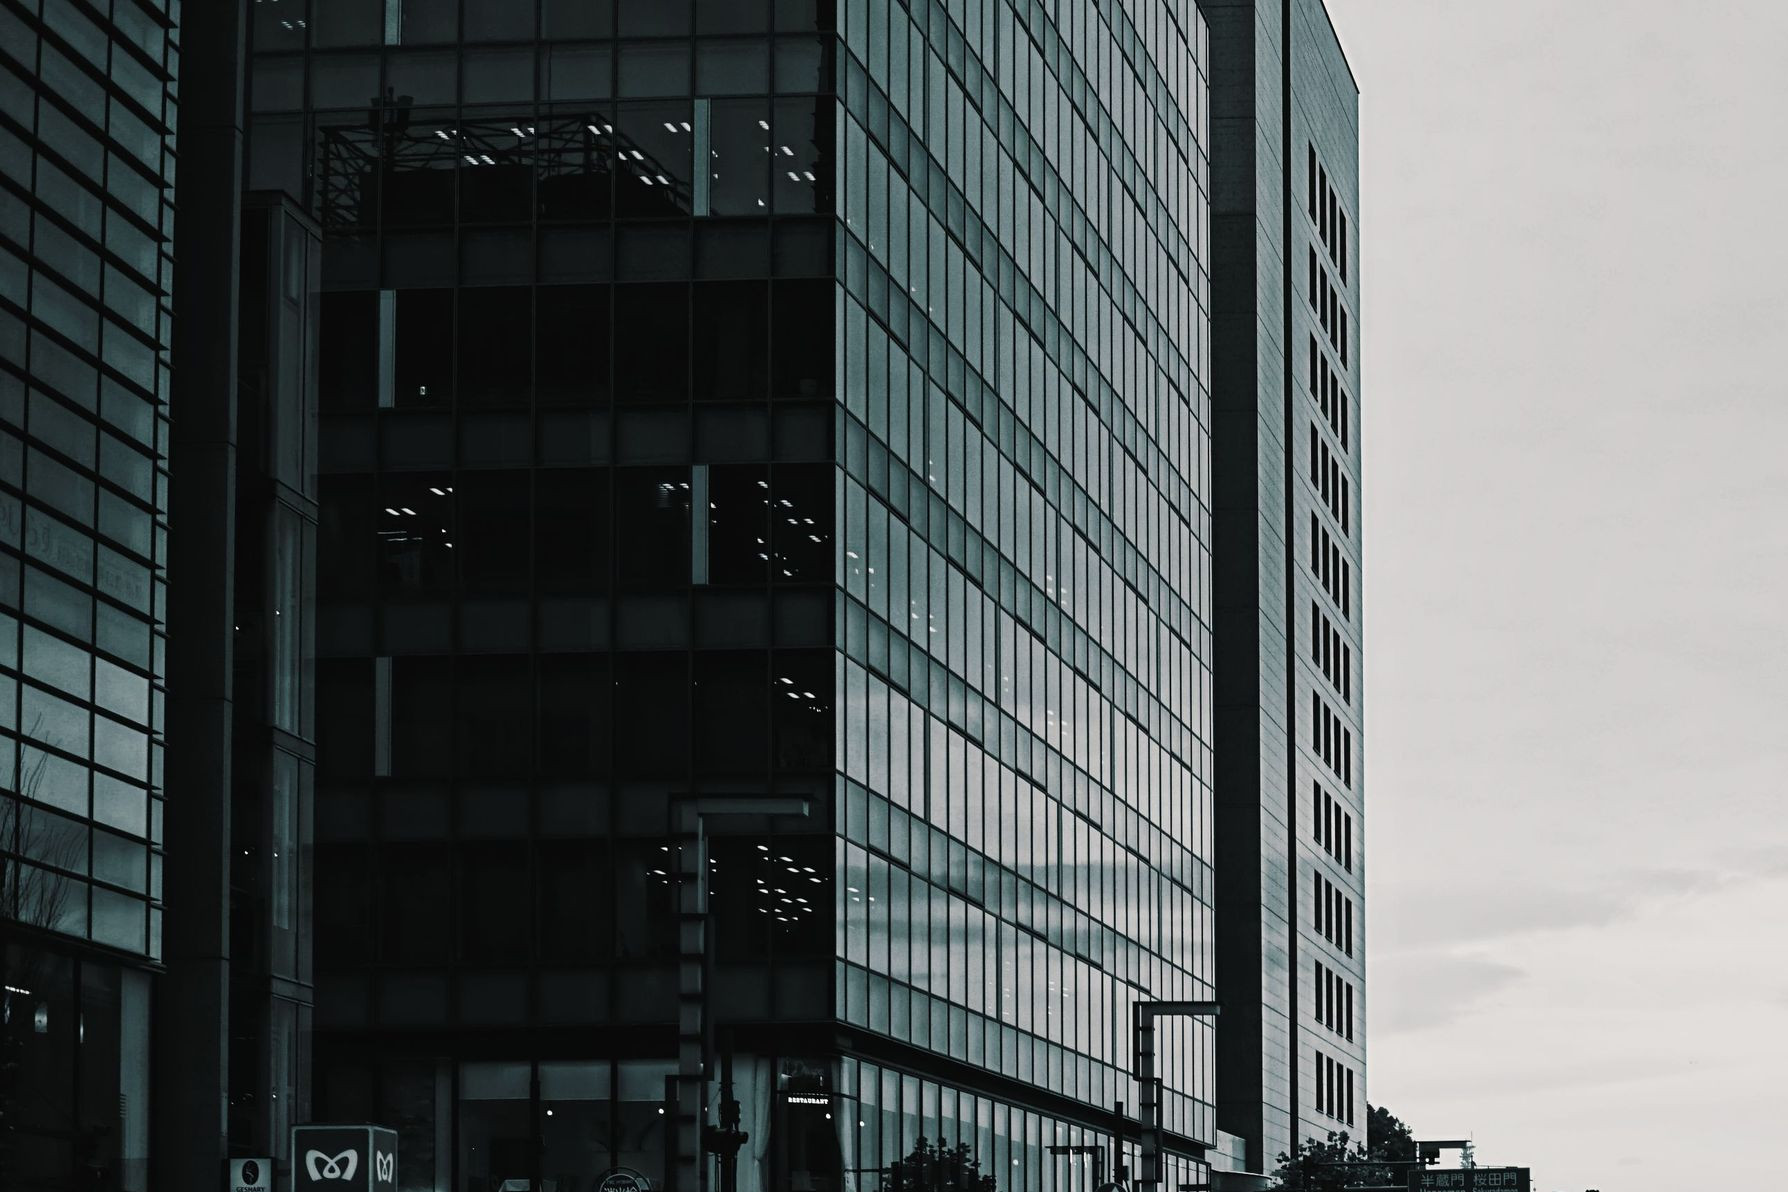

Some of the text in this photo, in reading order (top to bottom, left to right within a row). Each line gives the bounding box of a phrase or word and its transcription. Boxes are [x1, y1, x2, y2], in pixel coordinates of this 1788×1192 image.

[1420, 1172, 1517, 1188] 半蔵門 桜田門
